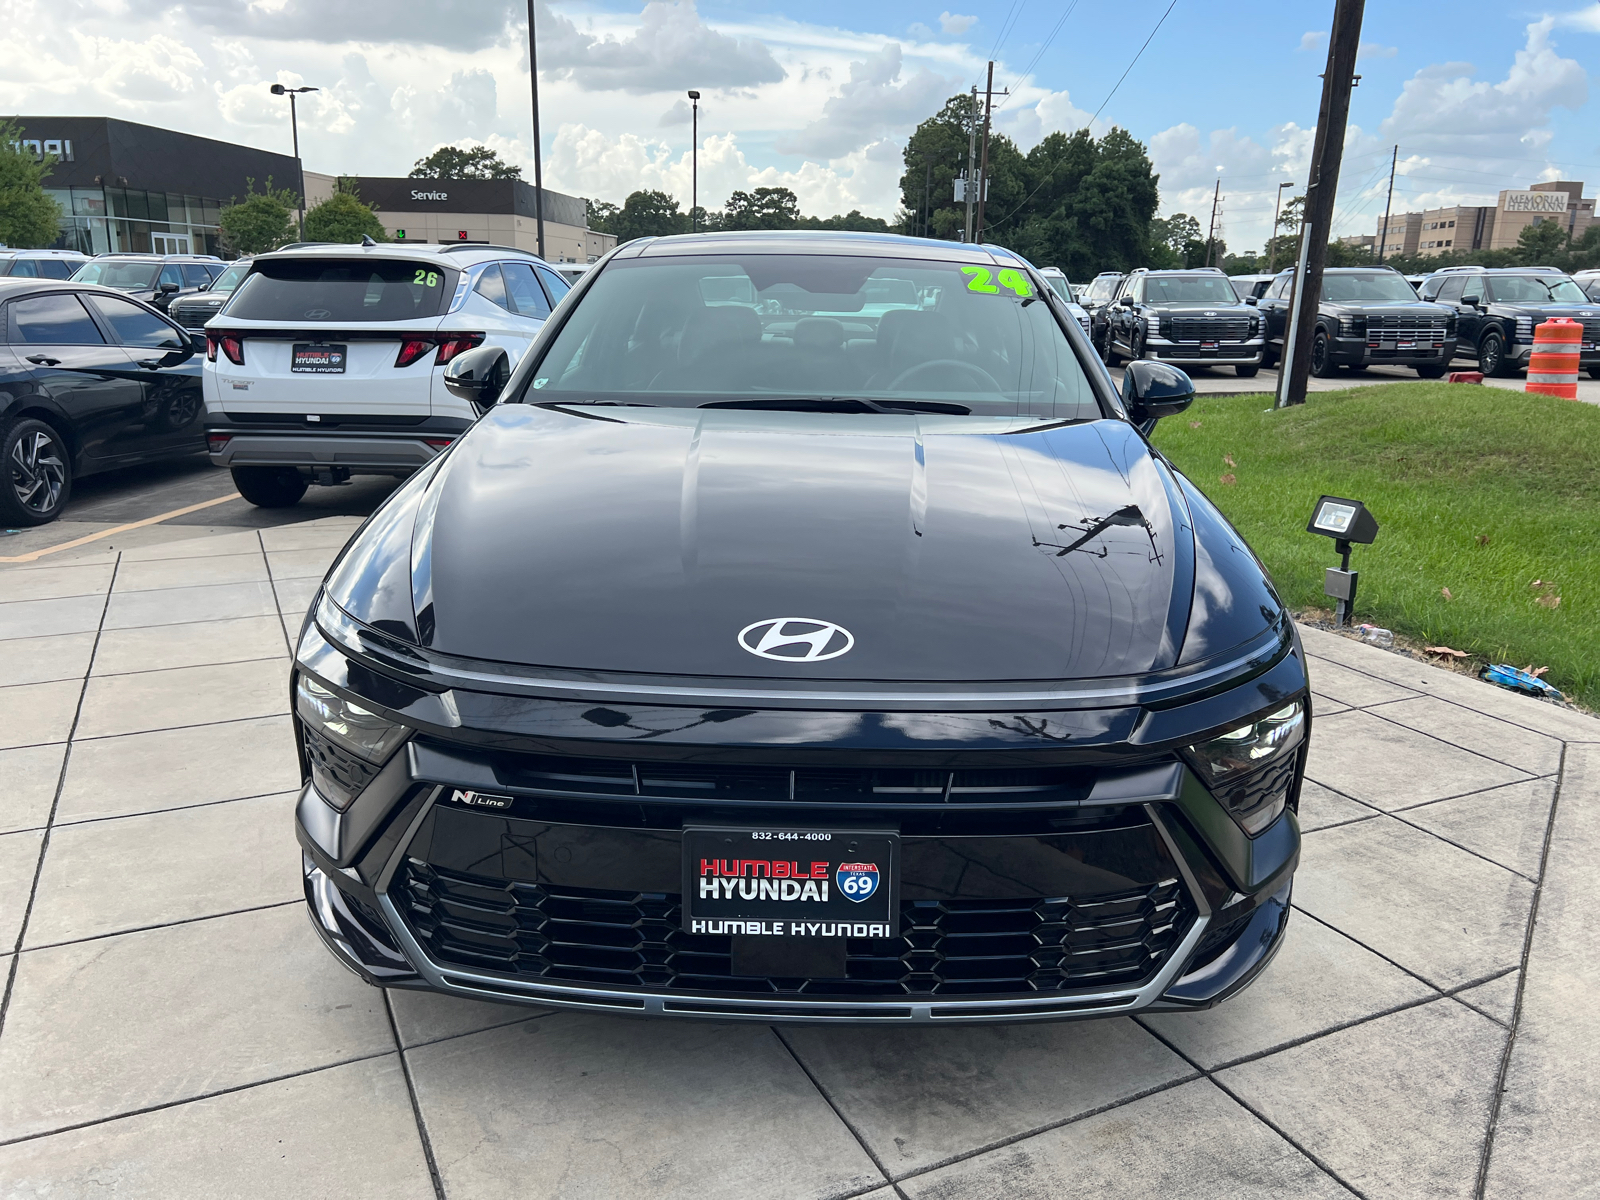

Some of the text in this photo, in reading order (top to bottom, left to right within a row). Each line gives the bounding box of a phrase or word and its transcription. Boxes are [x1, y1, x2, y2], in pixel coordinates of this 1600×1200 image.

[410, 189, 448, 201] Service
[1510, 194, 1565, 204] MEMORIAL
[1508, 201, 1563, 211] HERMANN
[413, 269, 438, 288] 26
[960, 266, 1033, 298] 24
[295, 357, 329, 365] HYUNDAI
[477, 798, 505, 807] Line
[751, 831, 832, 842] 832-644-4000
[700, 858, 830, 879] HUMBLE
[699, 877, 829, 902] HYUNDAI
[843, 876, 873, 895] 69
[691, 919, 891, 938] HUMBLE HYUNDAI
